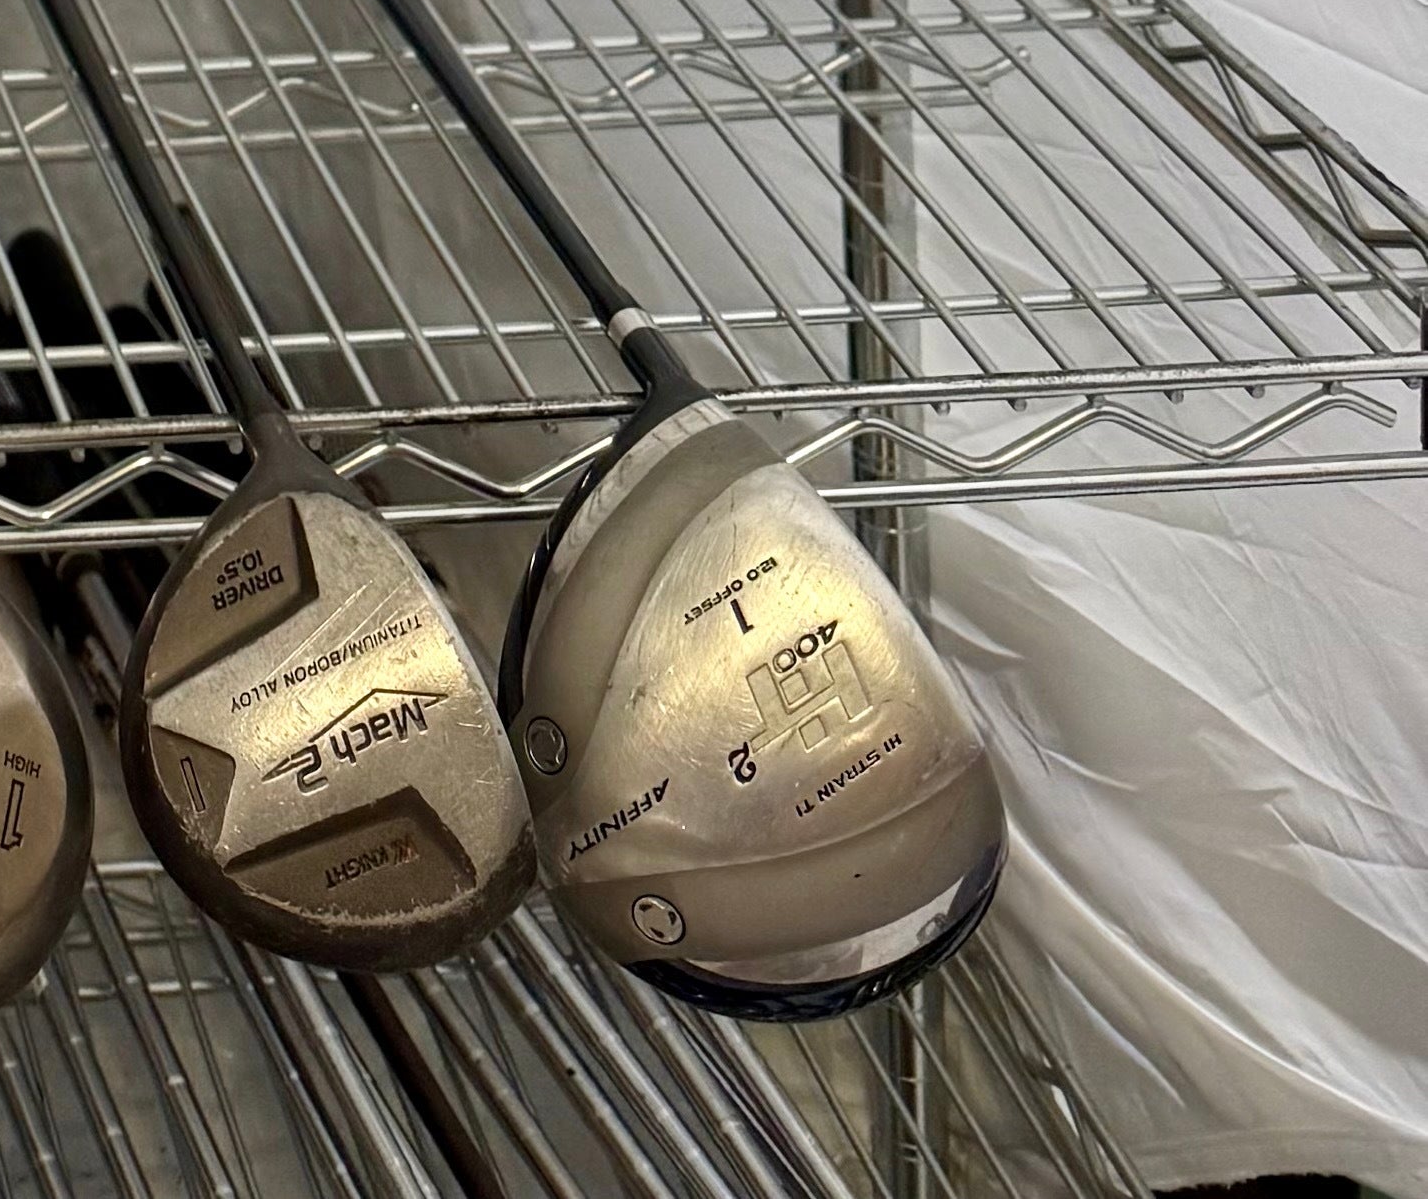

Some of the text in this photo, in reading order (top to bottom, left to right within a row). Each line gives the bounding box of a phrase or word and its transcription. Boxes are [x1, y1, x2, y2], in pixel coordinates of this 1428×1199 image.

[211, 564, 284, 612] DRIVER
[216, 549, 264, 585] 10.5°
[683, 579, 745, 626] OFFSET
[728, 598, 755, 636] 1
[772, 619, 842, 675] 400
[230, 677, 278, 715] ALLOY
[3, 749, 43, 780] HIGH
[295, 701, 429, 797] Mach 2
[882, 731, 903, 752] HI
[817, 746, 882, 807] STRAIN
[0, 778, 25, 852] 1
[568, 777, 670, 861] AFFINITY
[325, 849, 390, 890] KNIGHT
